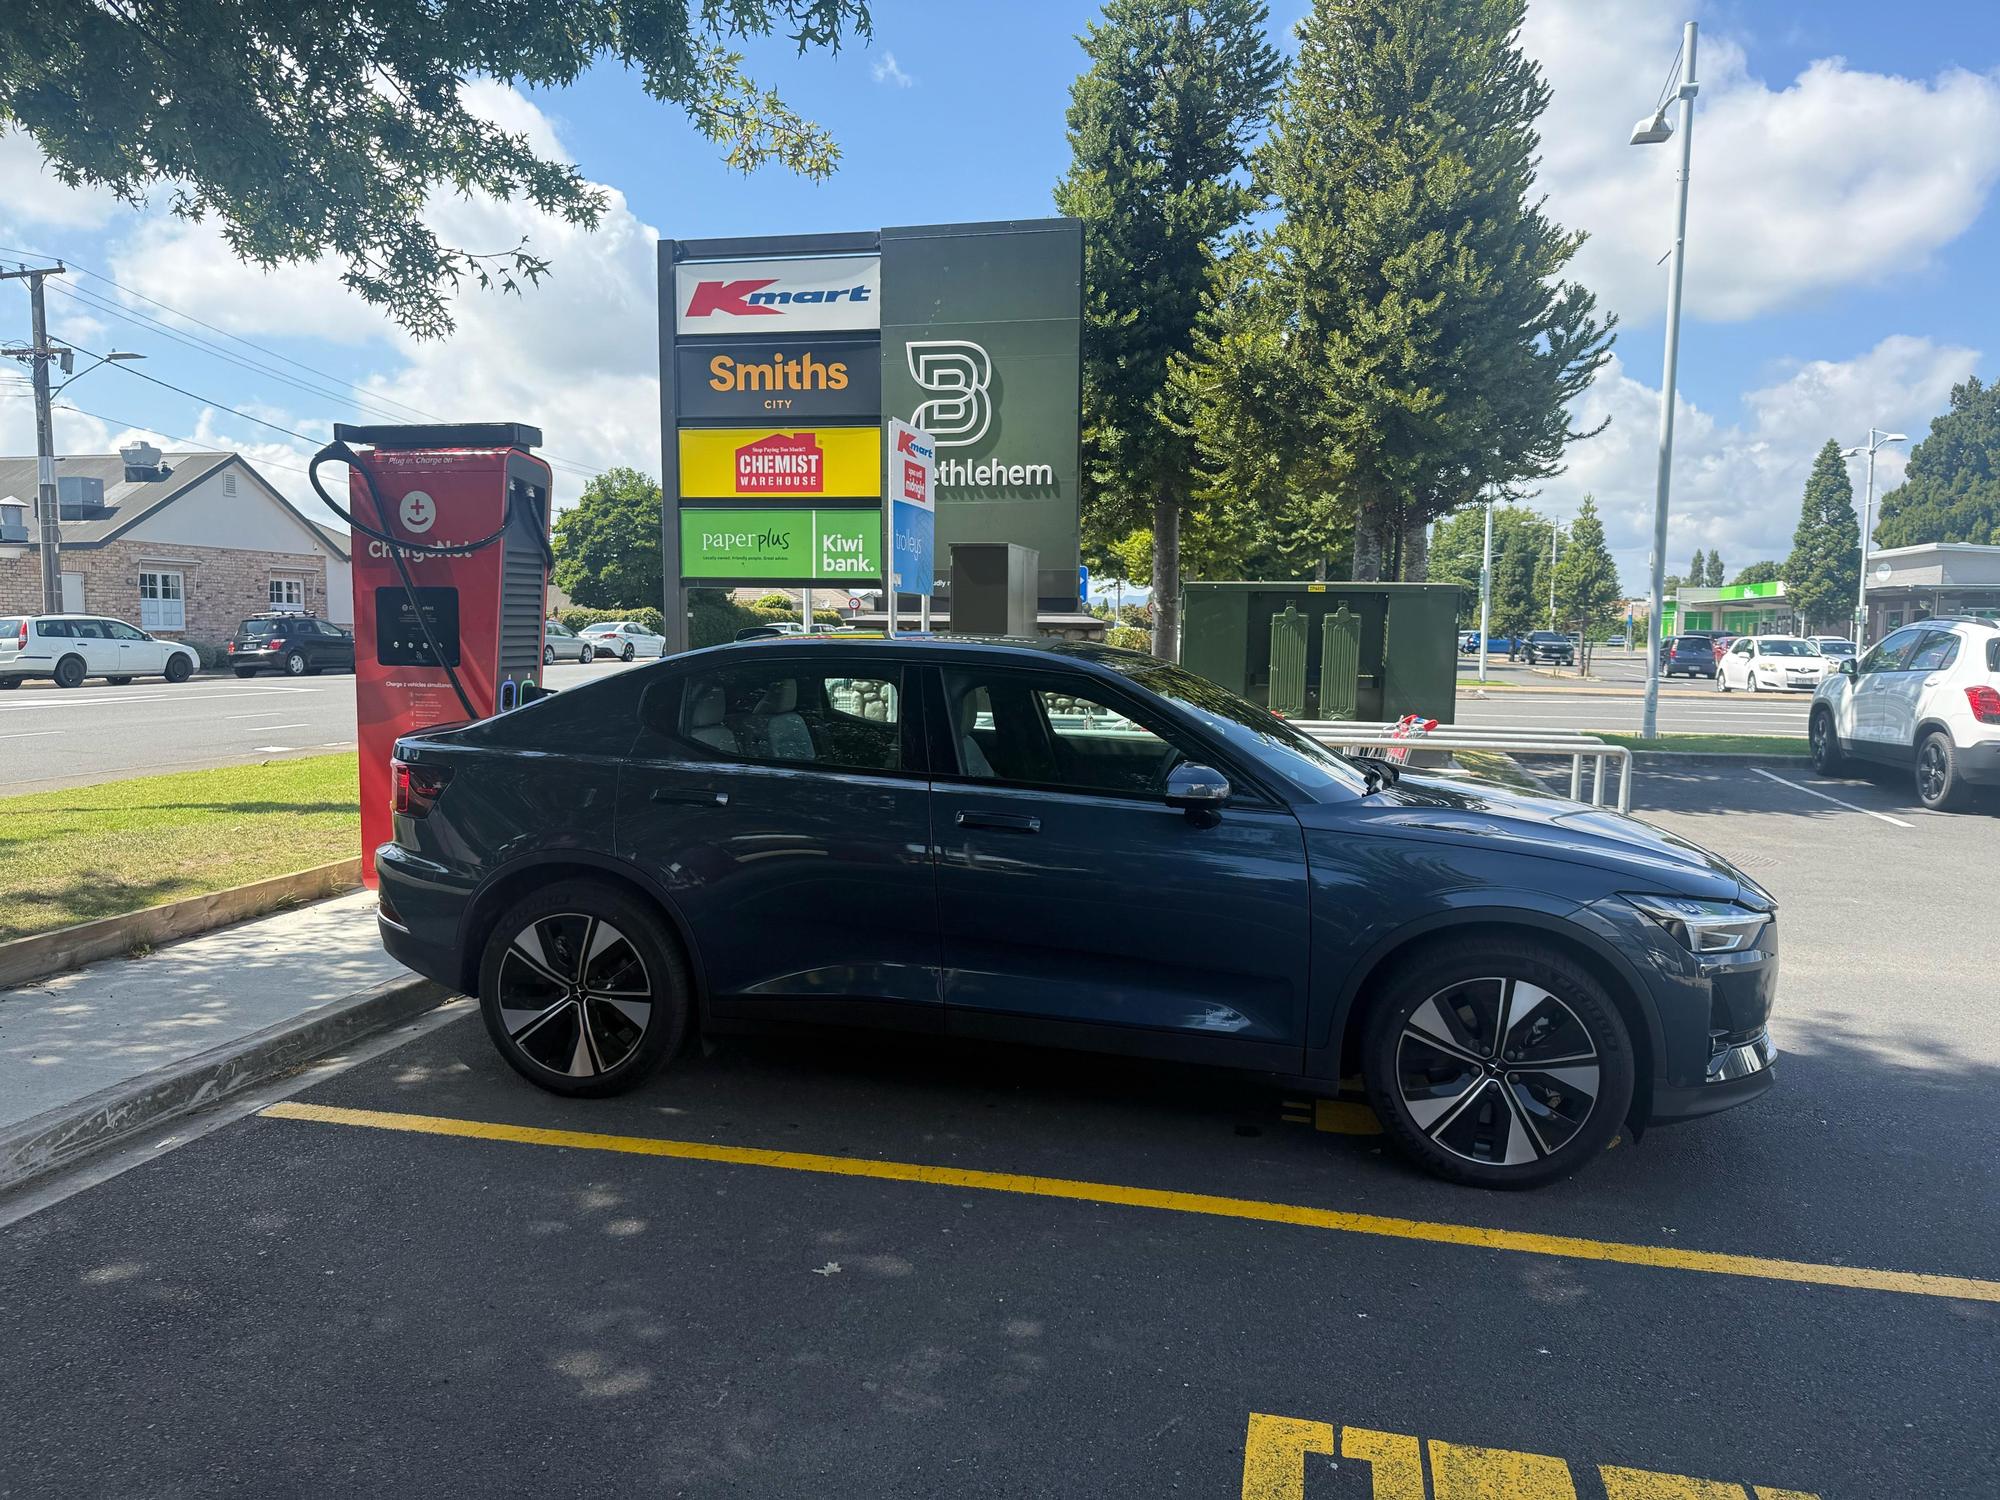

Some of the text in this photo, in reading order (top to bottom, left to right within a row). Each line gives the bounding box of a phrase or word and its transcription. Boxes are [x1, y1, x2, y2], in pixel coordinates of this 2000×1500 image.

[685, 279, 872, 317] Kmart
[709, 352, 849, 391] Smiths
[764, 400, 792, 409] CITY
[897, 430, 933, 459] Kmart
[388, 457, 404, 466] Plug
[415, 457, 442, 466] Charge
[740, 455, 819, 474] CHEMIST
[740, 476, 816, 486] WAREHOUSE
[933, 458, 1053, 487] ethlehem
[906, 477, 925, 498] midnight
[823, 534, 863, 552] Kiwi
[895, 528, 922, 561] trolleys
[823, 553, 875, 572] bank.
